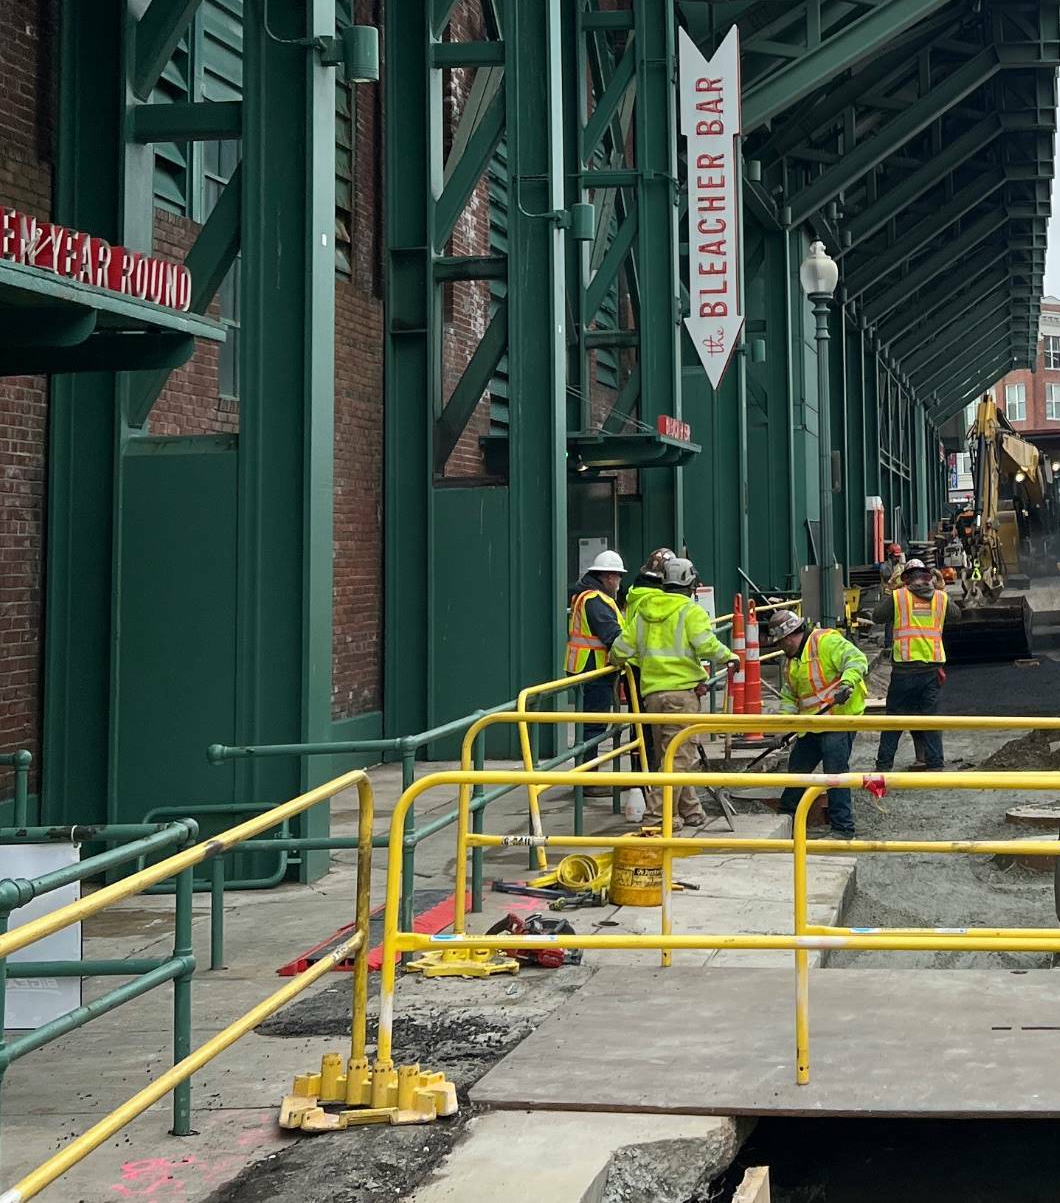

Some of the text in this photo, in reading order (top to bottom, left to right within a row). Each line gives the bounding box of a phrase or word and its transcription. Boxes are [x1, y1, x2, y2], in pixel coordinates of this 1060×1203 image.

[51, 224, 112, 290] YEAR
[121, 250, 192, 312] ROUND
[695, 75, 728, 358] the BLEACHER BAR
